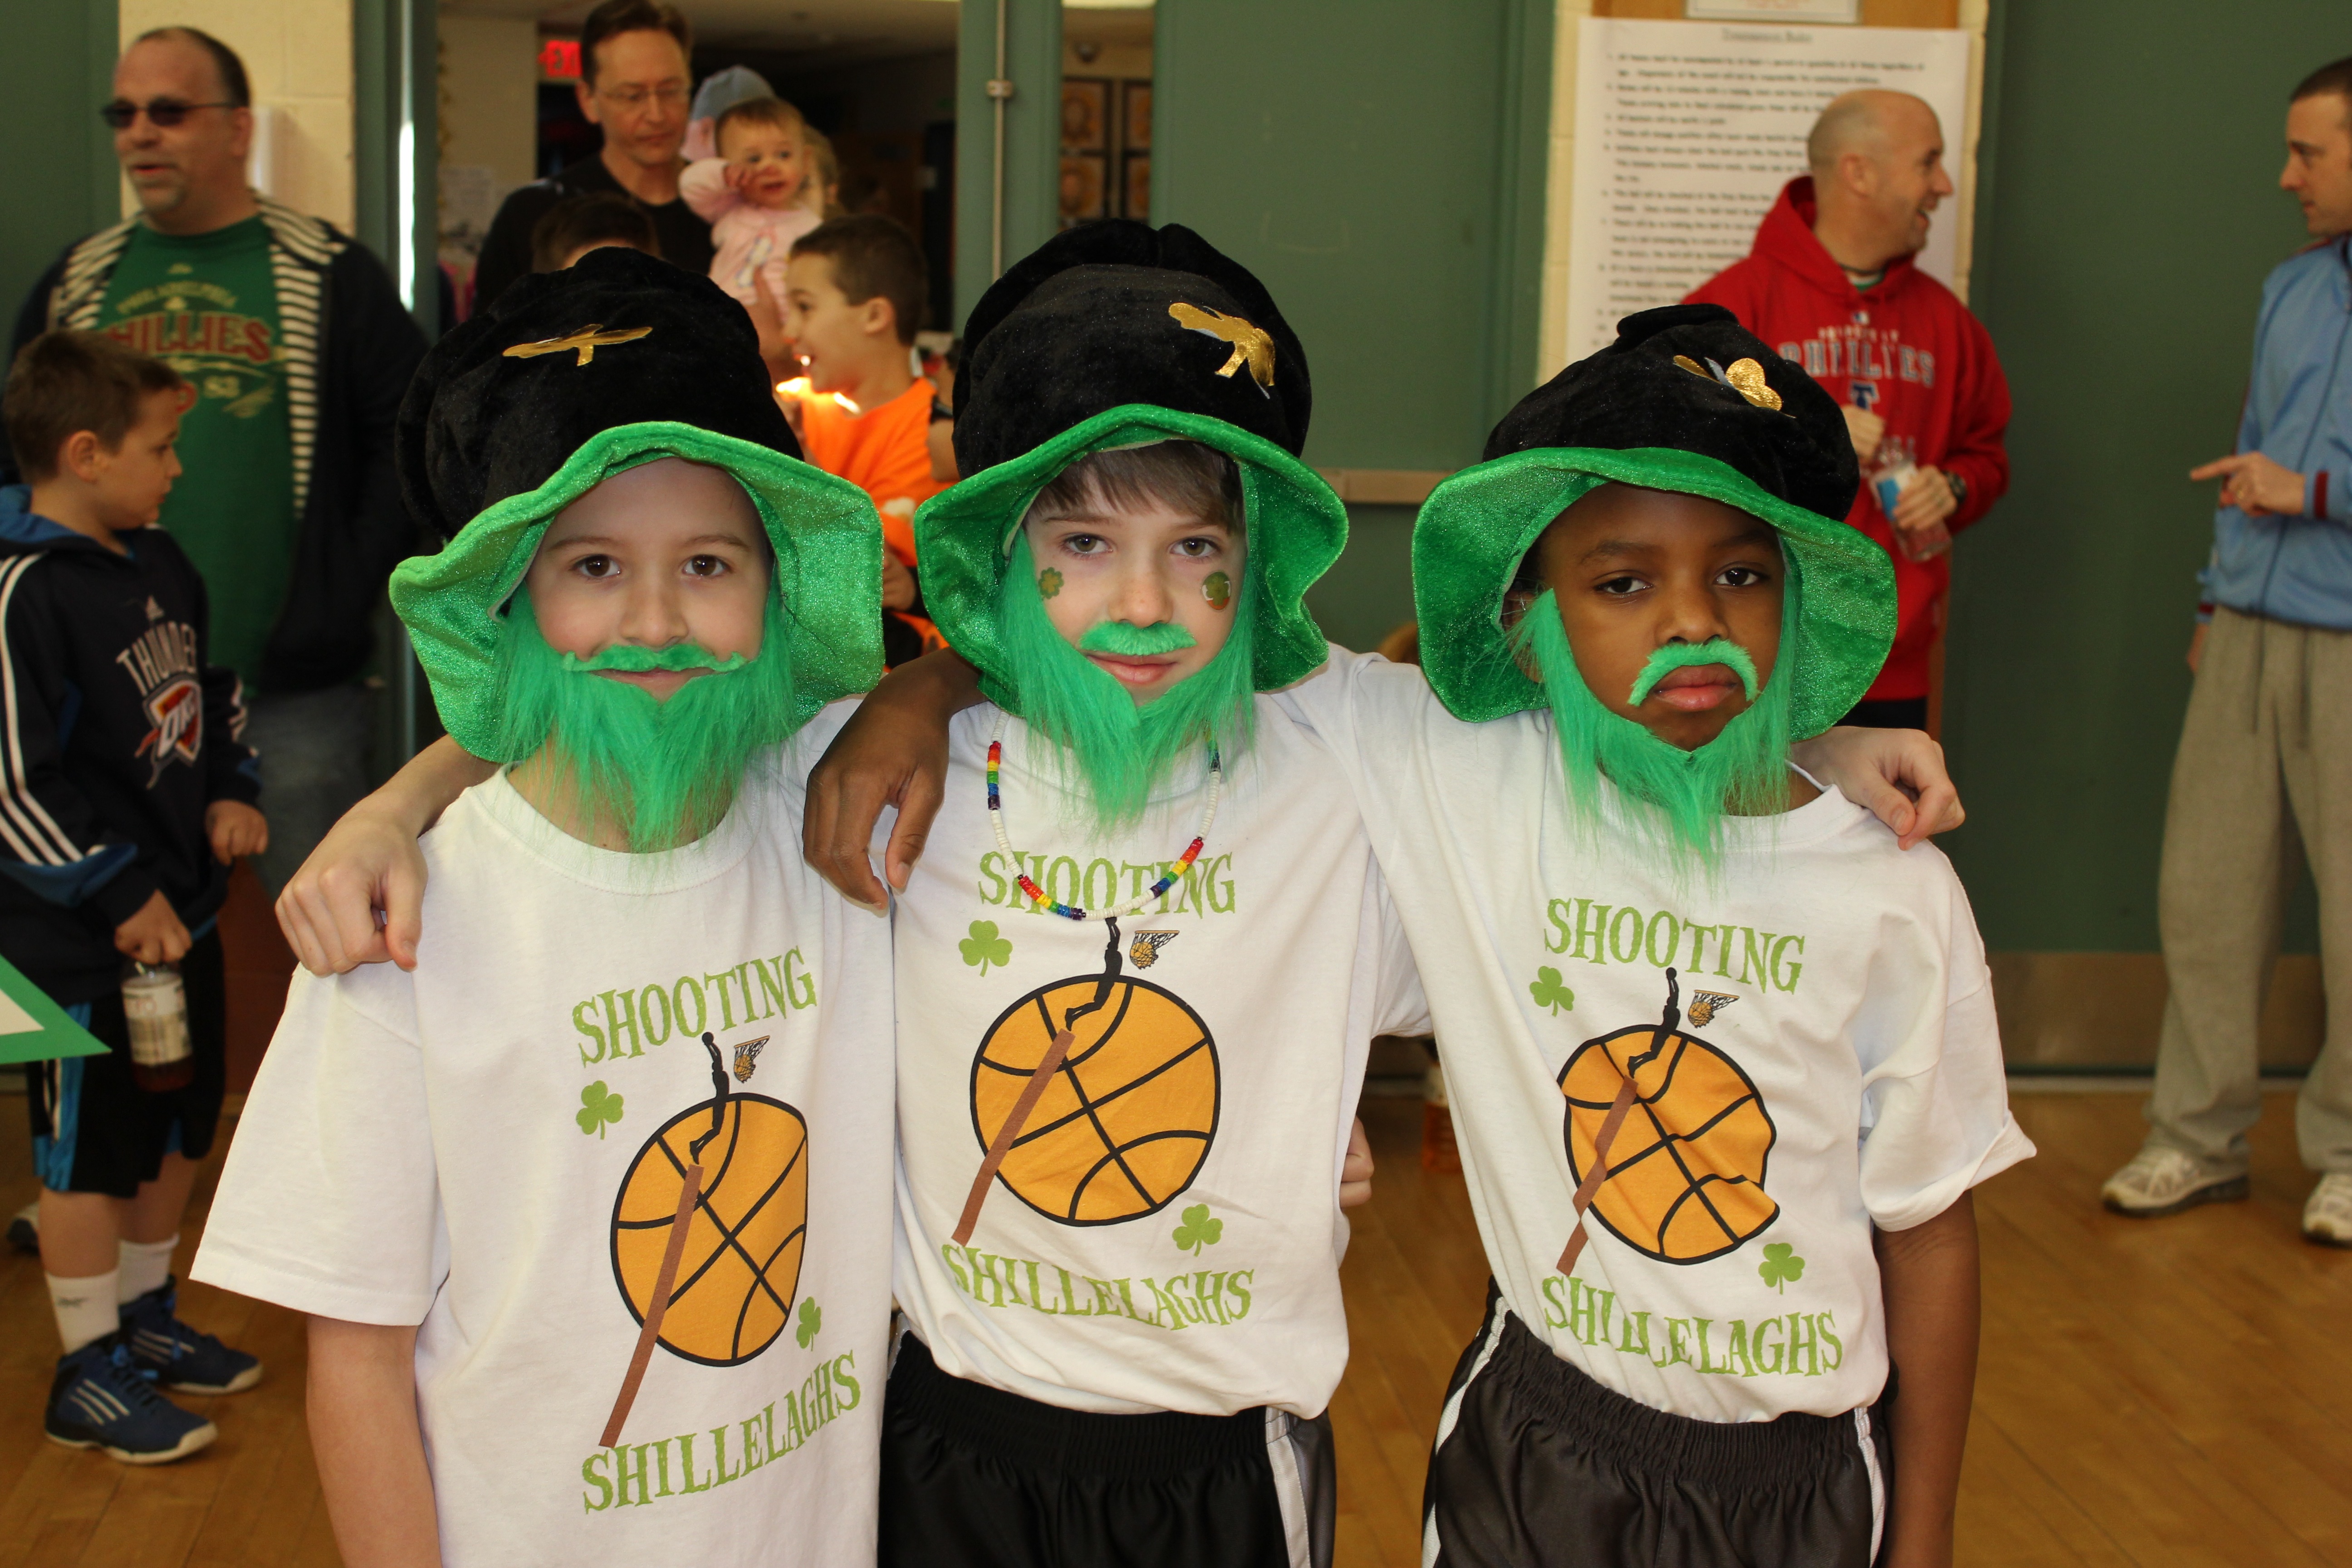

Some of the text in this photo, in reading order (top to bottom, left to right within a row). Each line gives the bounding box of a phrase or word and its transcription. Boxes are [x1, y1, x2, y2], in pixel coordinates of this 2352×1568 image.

[102, 312, 272, 364] HILLIES
[978, 851, 1235, 919] SHOOTING
[1544, 897, 1805, 995] SHOOTING
[572, 945, 817, 1068] SHOOTING
[941, 1244, 1255, 1331] SHILLELAGHS
[582, 1349, 861, 1514] SHILLELAGHS
